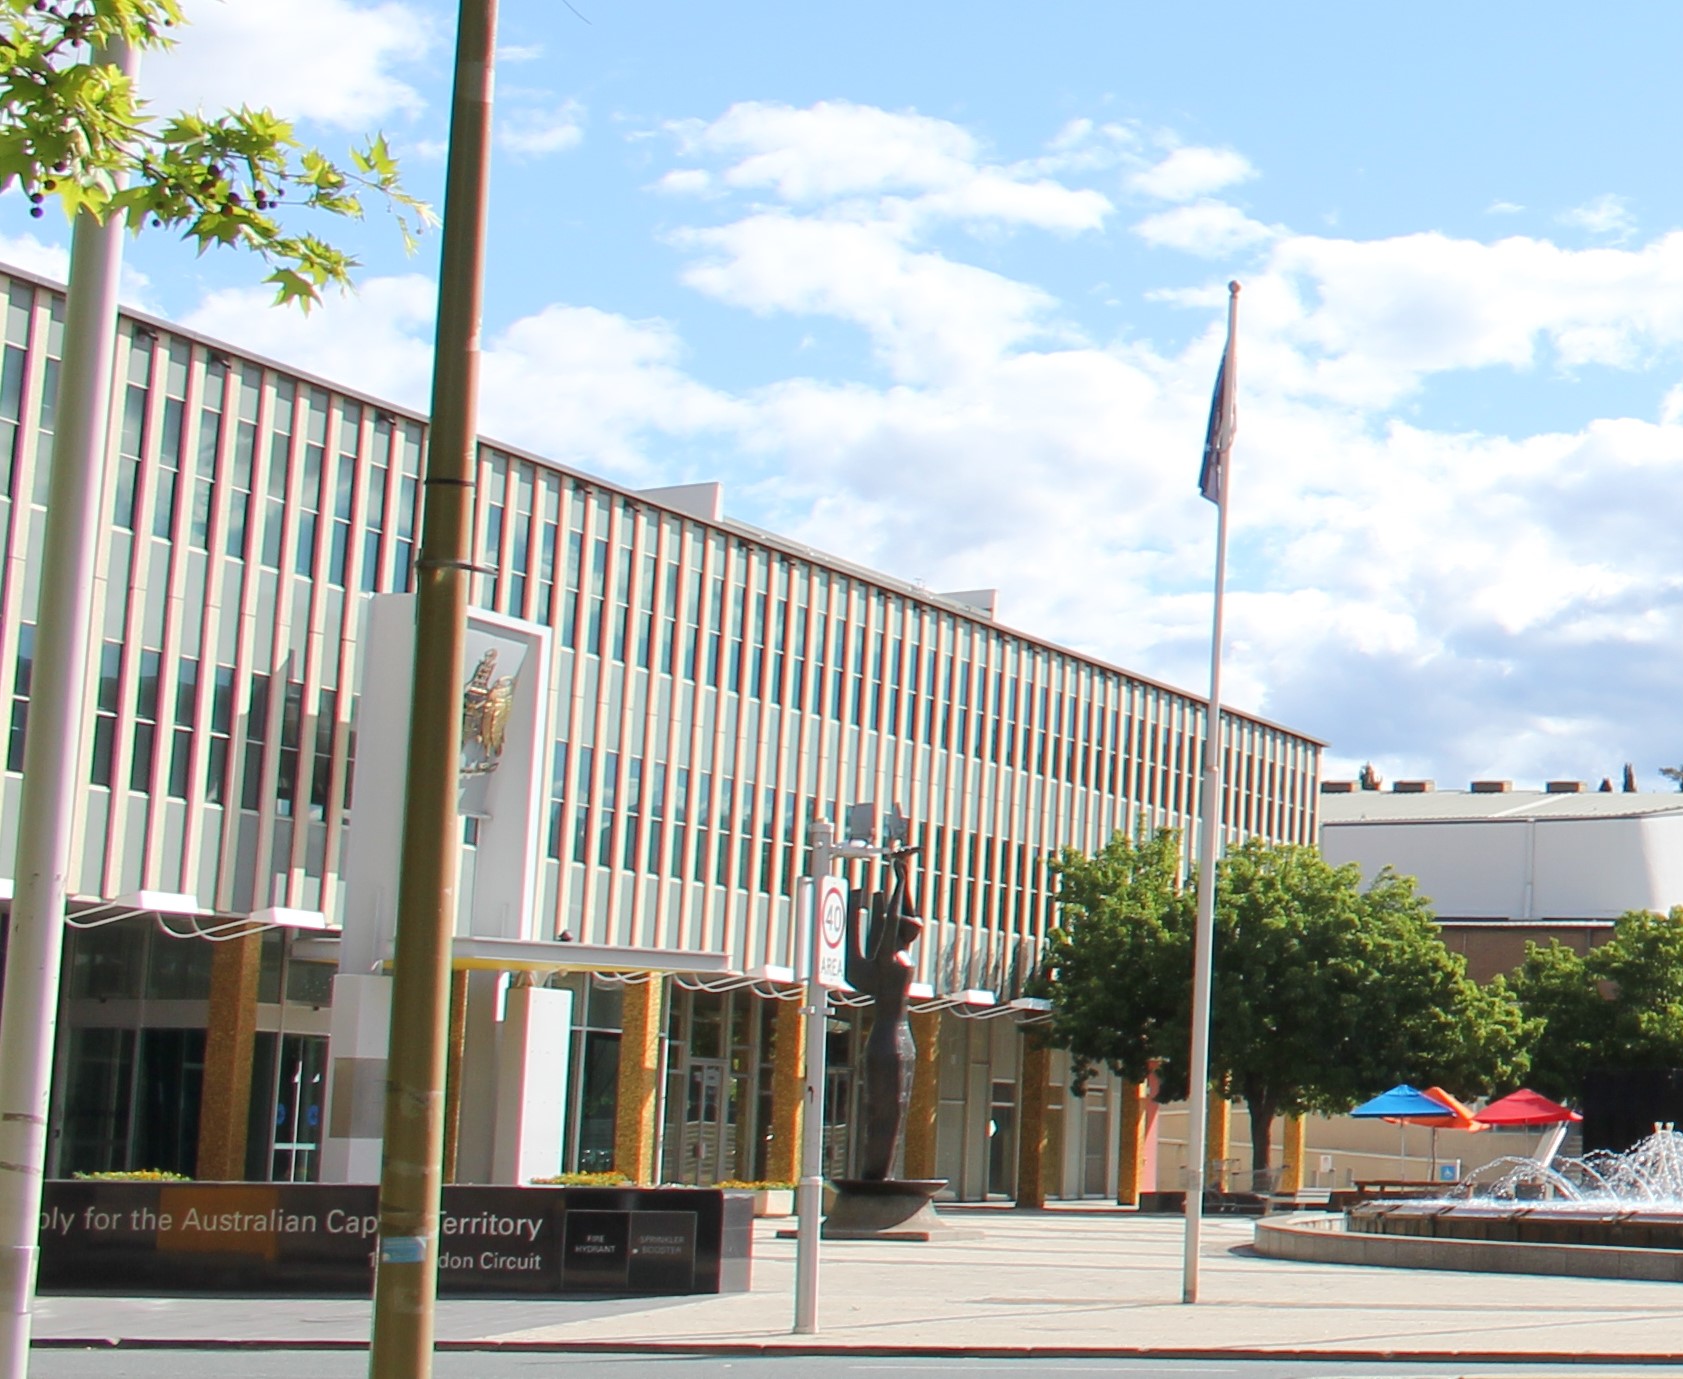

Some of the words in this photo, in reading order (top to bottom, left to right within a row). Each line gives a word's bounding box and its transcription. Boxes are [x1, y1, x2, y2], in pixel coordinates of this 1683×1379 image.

[825, 904, 842, 932] 40
[821, 956, 843, 977] AREA
[84, 1206, 122, 1230] for
[131, 1206, 173, 1231] the
[180, 1207, 317, 1232] Australian
[440, 1210, 543, 1242] erritory
[586, 1235, 605, 1243] FIRE
[639, 1235, 685, 1243] SPRINKLER
[574, 1245, 616, 1254] HYDRANT
[642, 1245, 682, 1255] BOOSTER
[479, 1251, 542, 1270] Circuit
